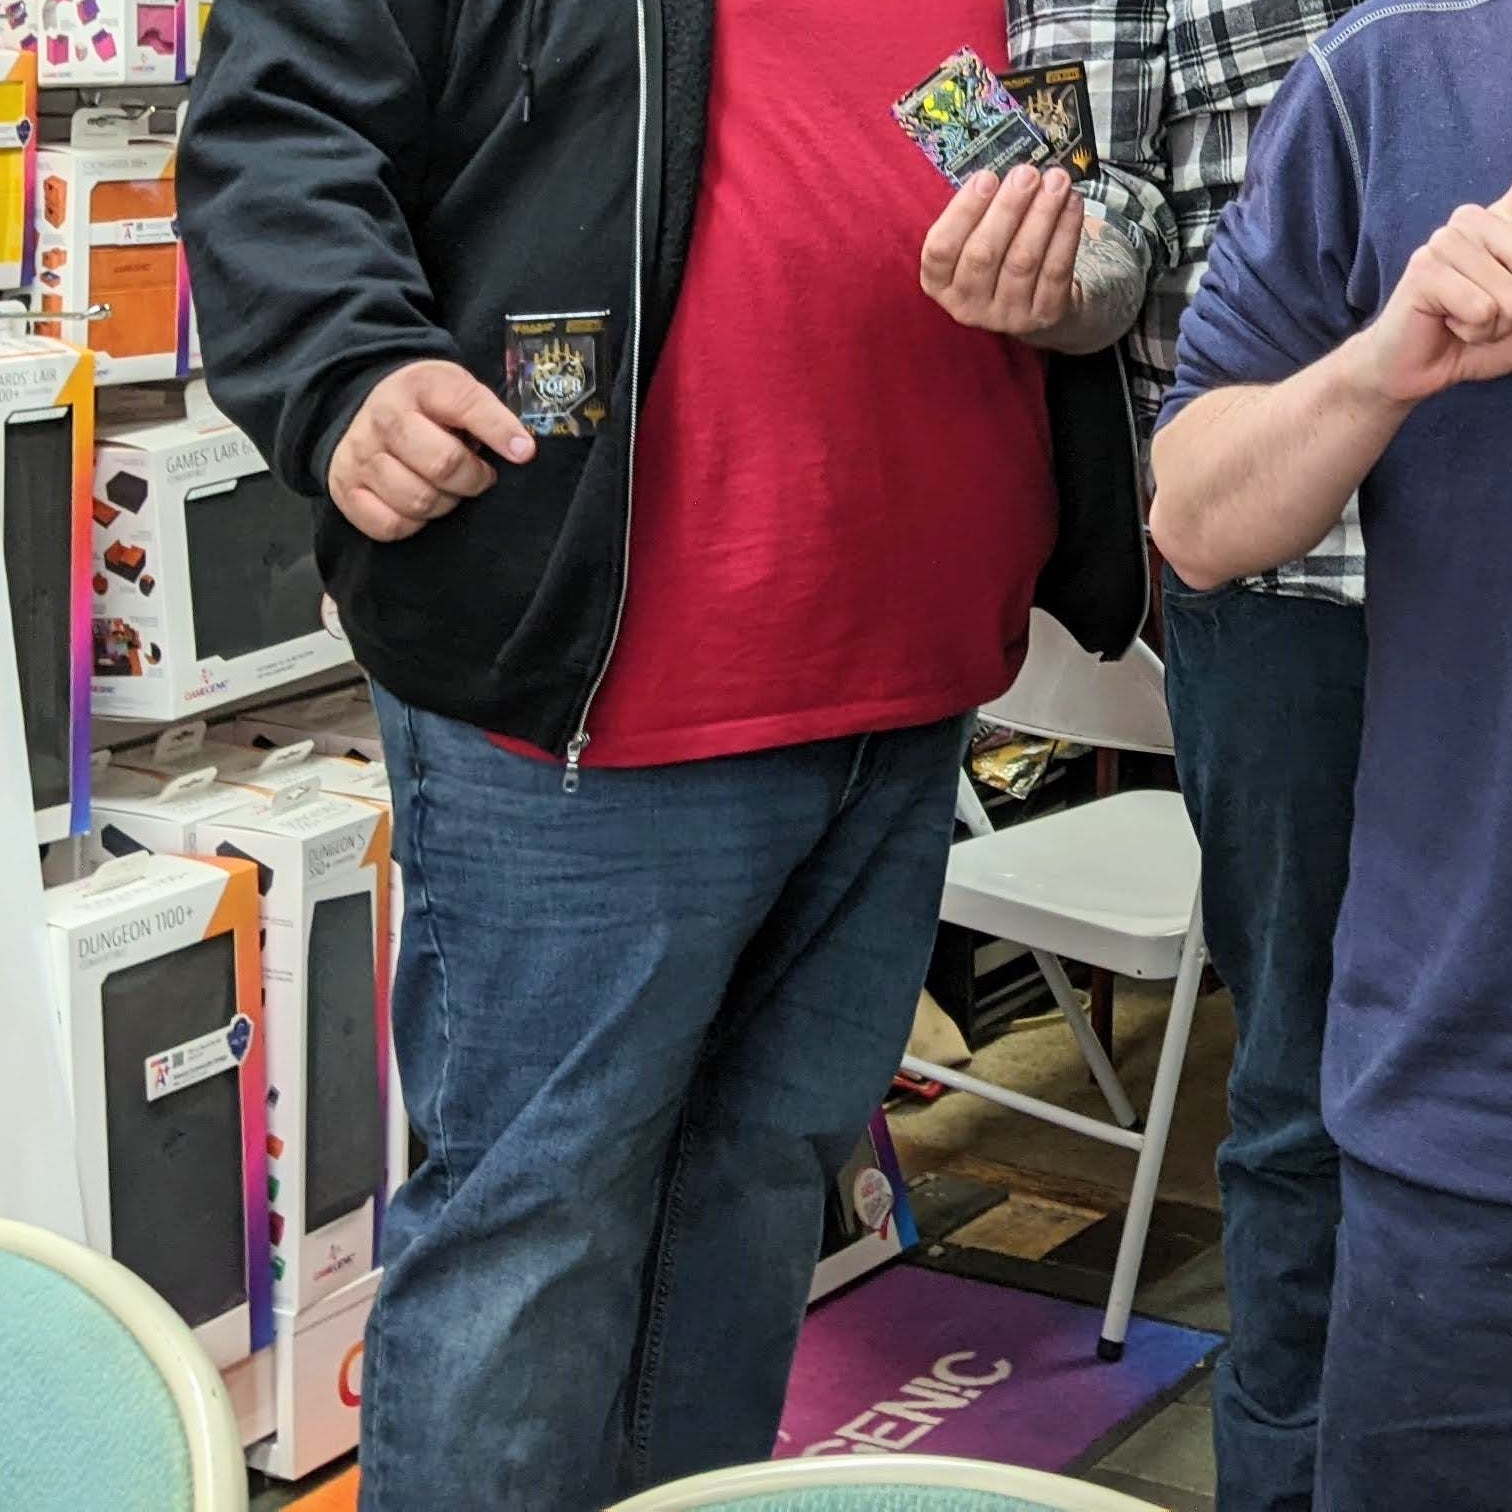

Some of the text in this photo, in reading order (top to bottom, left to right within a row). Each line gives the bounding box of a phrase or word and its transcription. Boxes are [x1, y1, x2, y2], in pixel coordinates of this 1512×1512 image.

[33, 368, 57, 384] LAIR
[213, 439, 240, 463] LAIR
[308, 836, 355, 864] DUNGEON
[79, 904, 194, 958] DUNGEON 1100+
